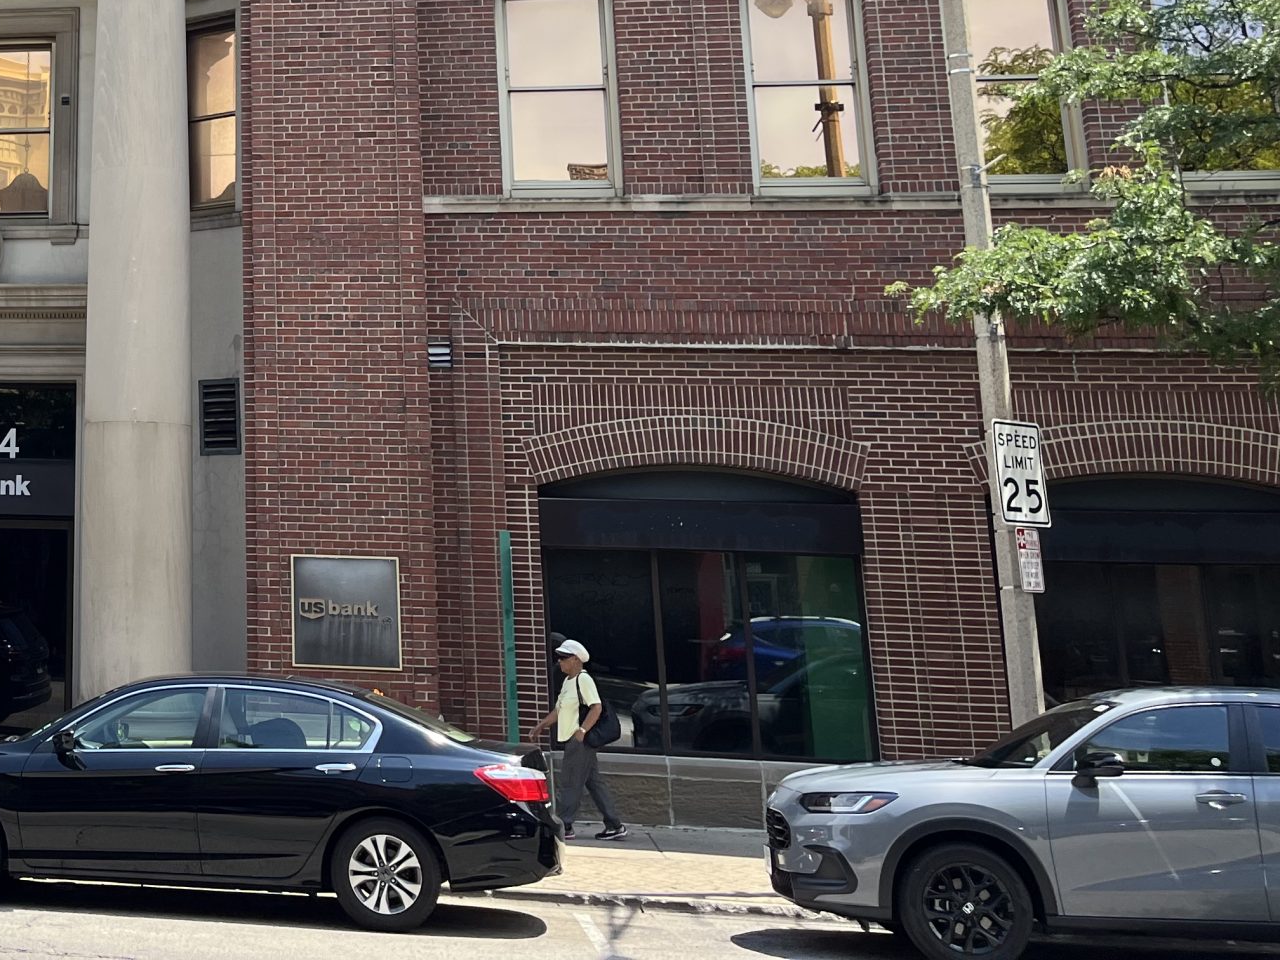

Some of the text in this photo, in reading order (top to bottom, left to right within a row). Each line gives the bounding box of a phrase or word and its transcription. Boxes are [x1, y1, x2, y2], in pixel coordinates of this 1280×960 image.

[997, 432, 1037, 450] SPEED
[1003, 455, 1034, 470] LIMIT
[1003, 477, 1043, 514] 25
